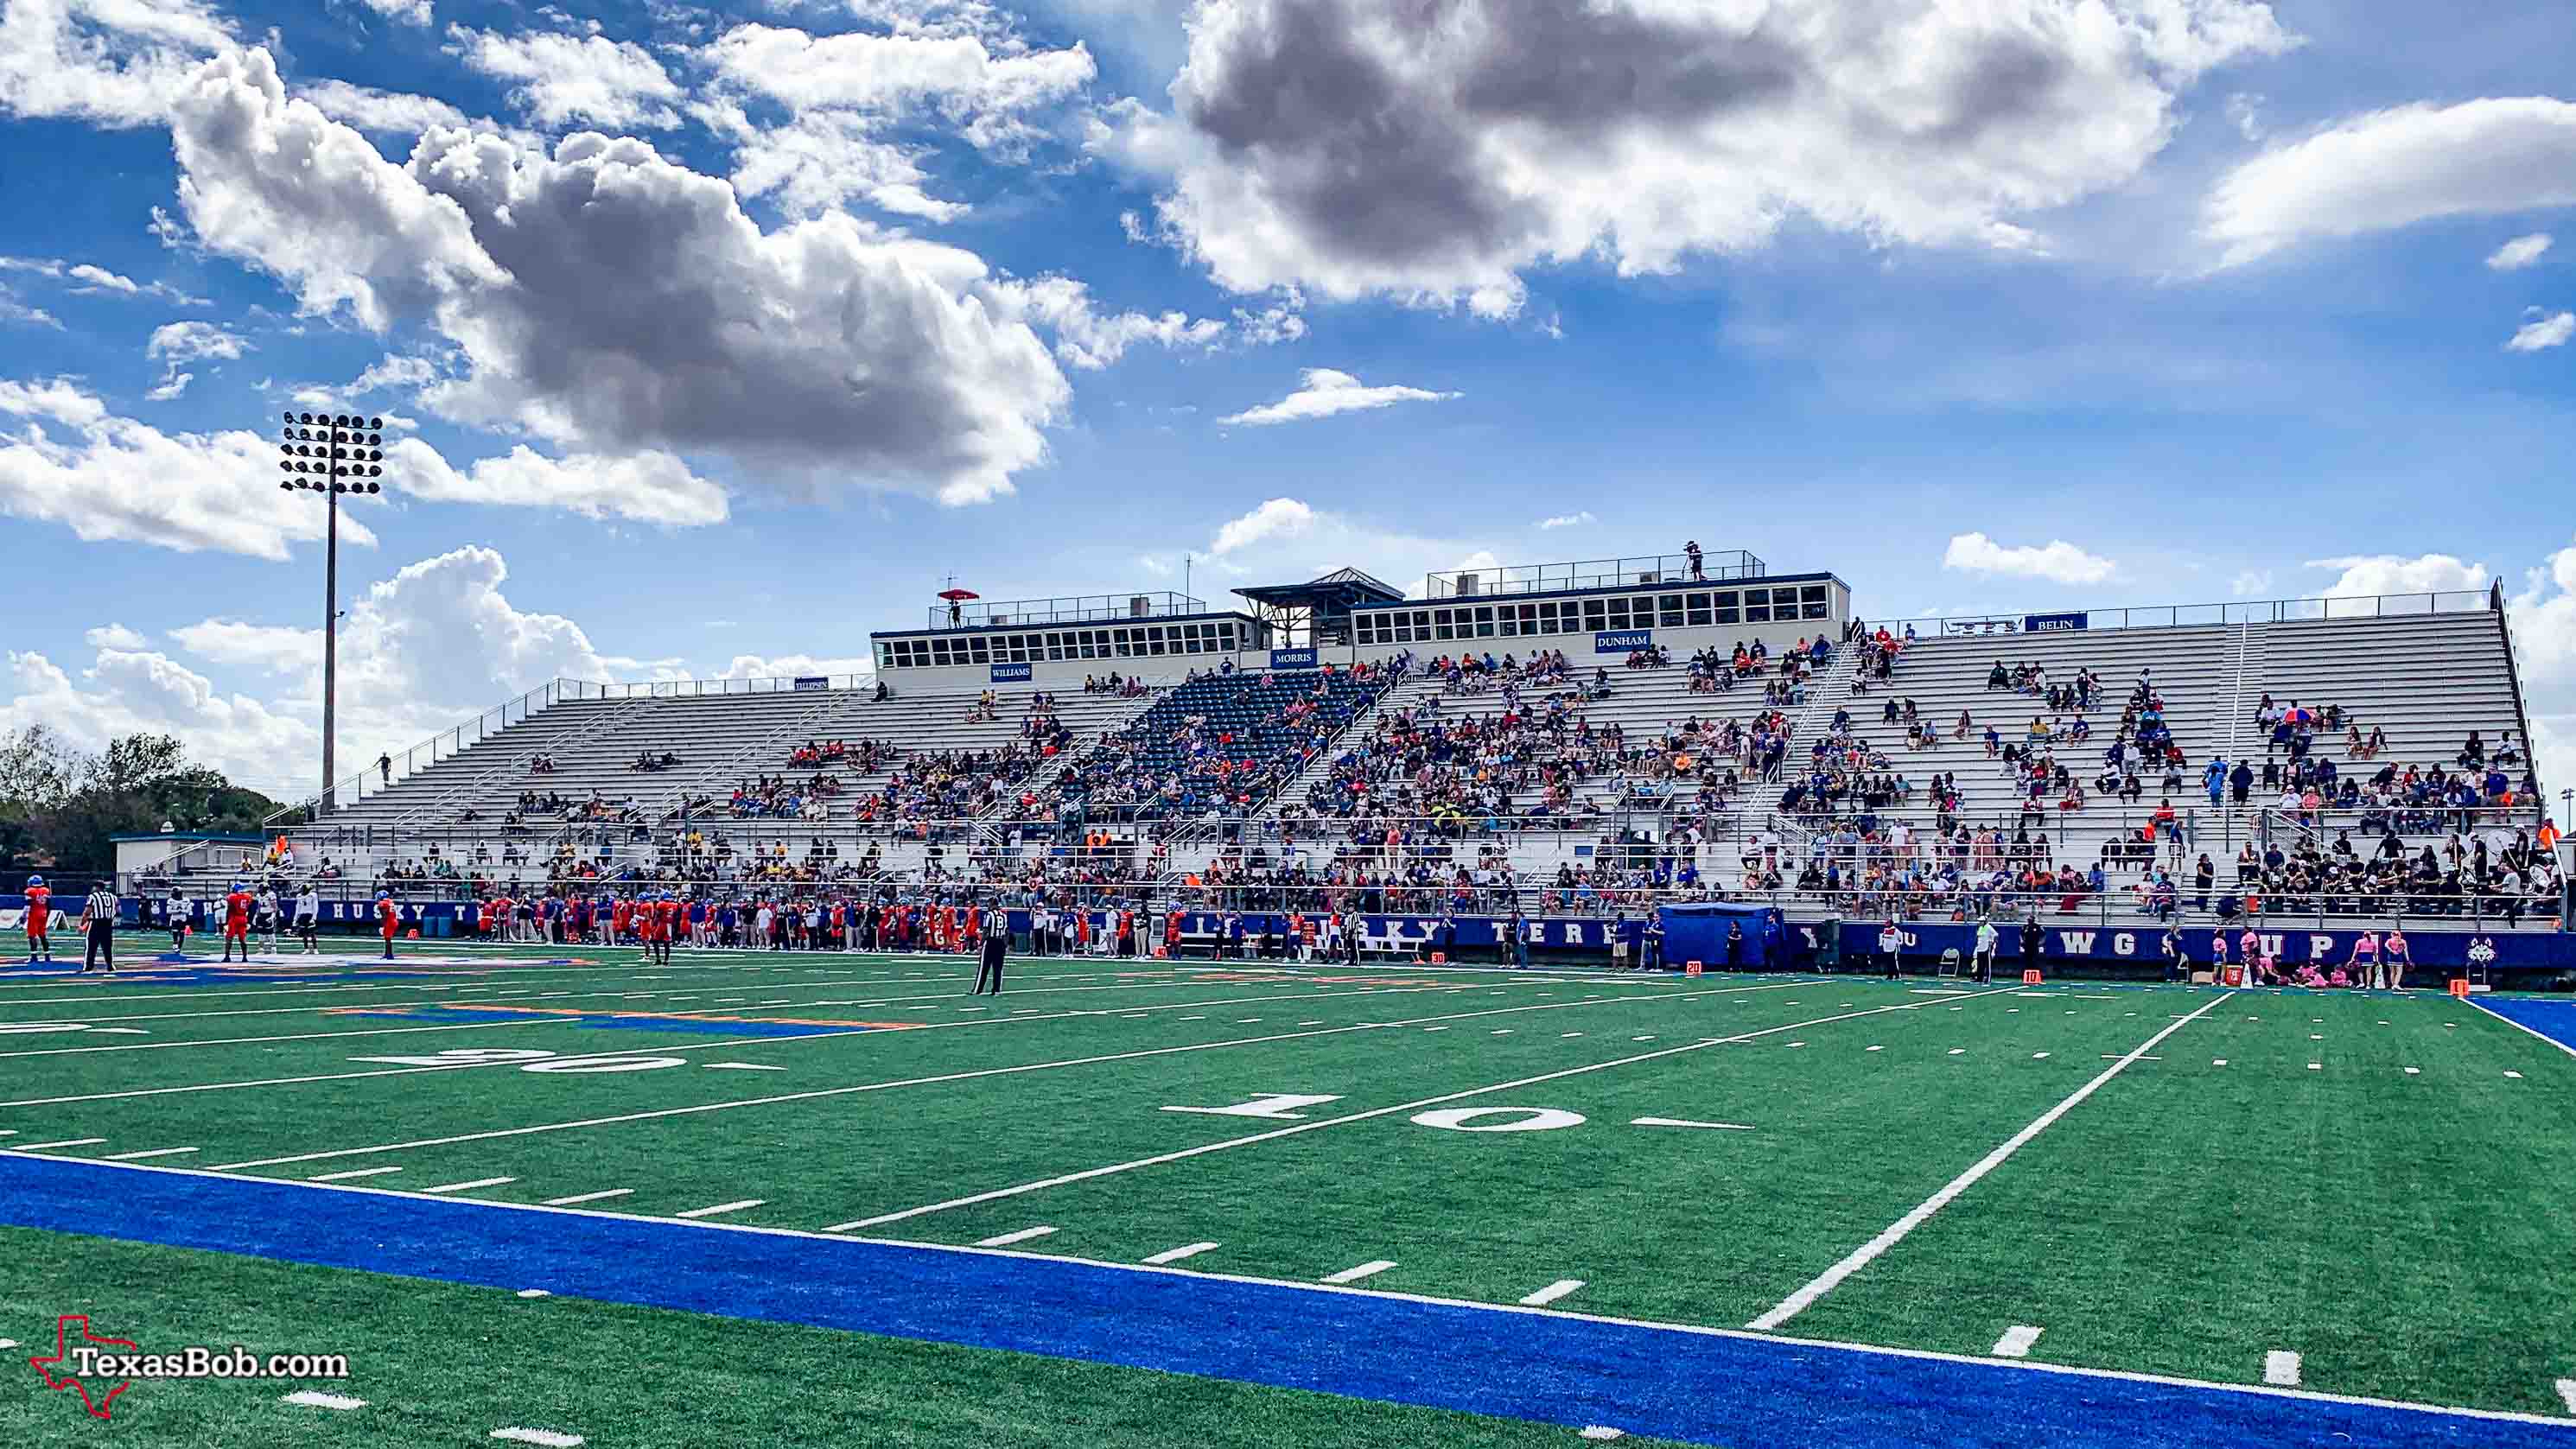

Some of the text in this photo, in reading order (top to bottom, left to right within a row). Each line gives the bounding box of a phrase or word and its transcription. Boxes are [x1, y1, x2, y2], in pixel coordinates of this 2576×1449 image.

[2039, 620, 2073, 630] BELIN
[1598, 636, 1647, 646] DUNHAM
[1276, 653, 1312, 664] MORRIS
[993, 668, 1030, 677] WILLIAMS
[1688, 963, 1700, 973] 20
